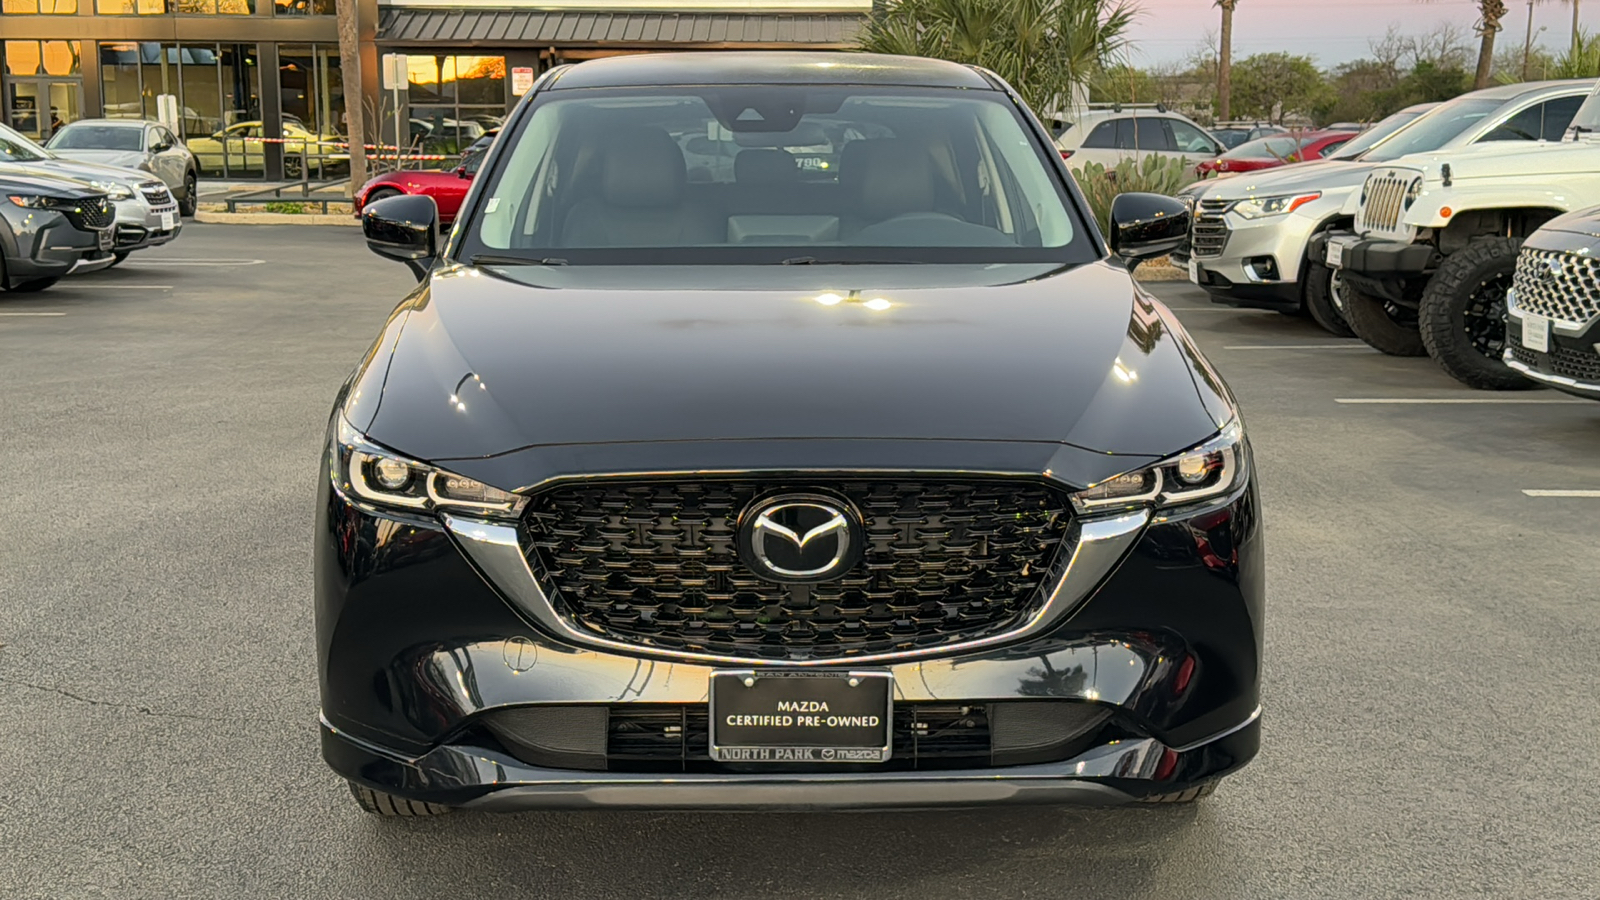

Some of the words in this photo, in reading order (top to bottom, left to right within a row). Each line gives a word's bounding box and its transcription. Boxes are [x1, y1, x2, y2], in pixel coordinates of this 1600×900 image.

[777, 701, 829, 712] MAZDA
[726, 715, 793, 727] CERTIFIED
[797, 715, 879, 727] PRE-OWNED
[721, 748, 770, 760] NORTH
[775, 748, 814, 760] PARK
[837, 750, 880, 760] mazda
